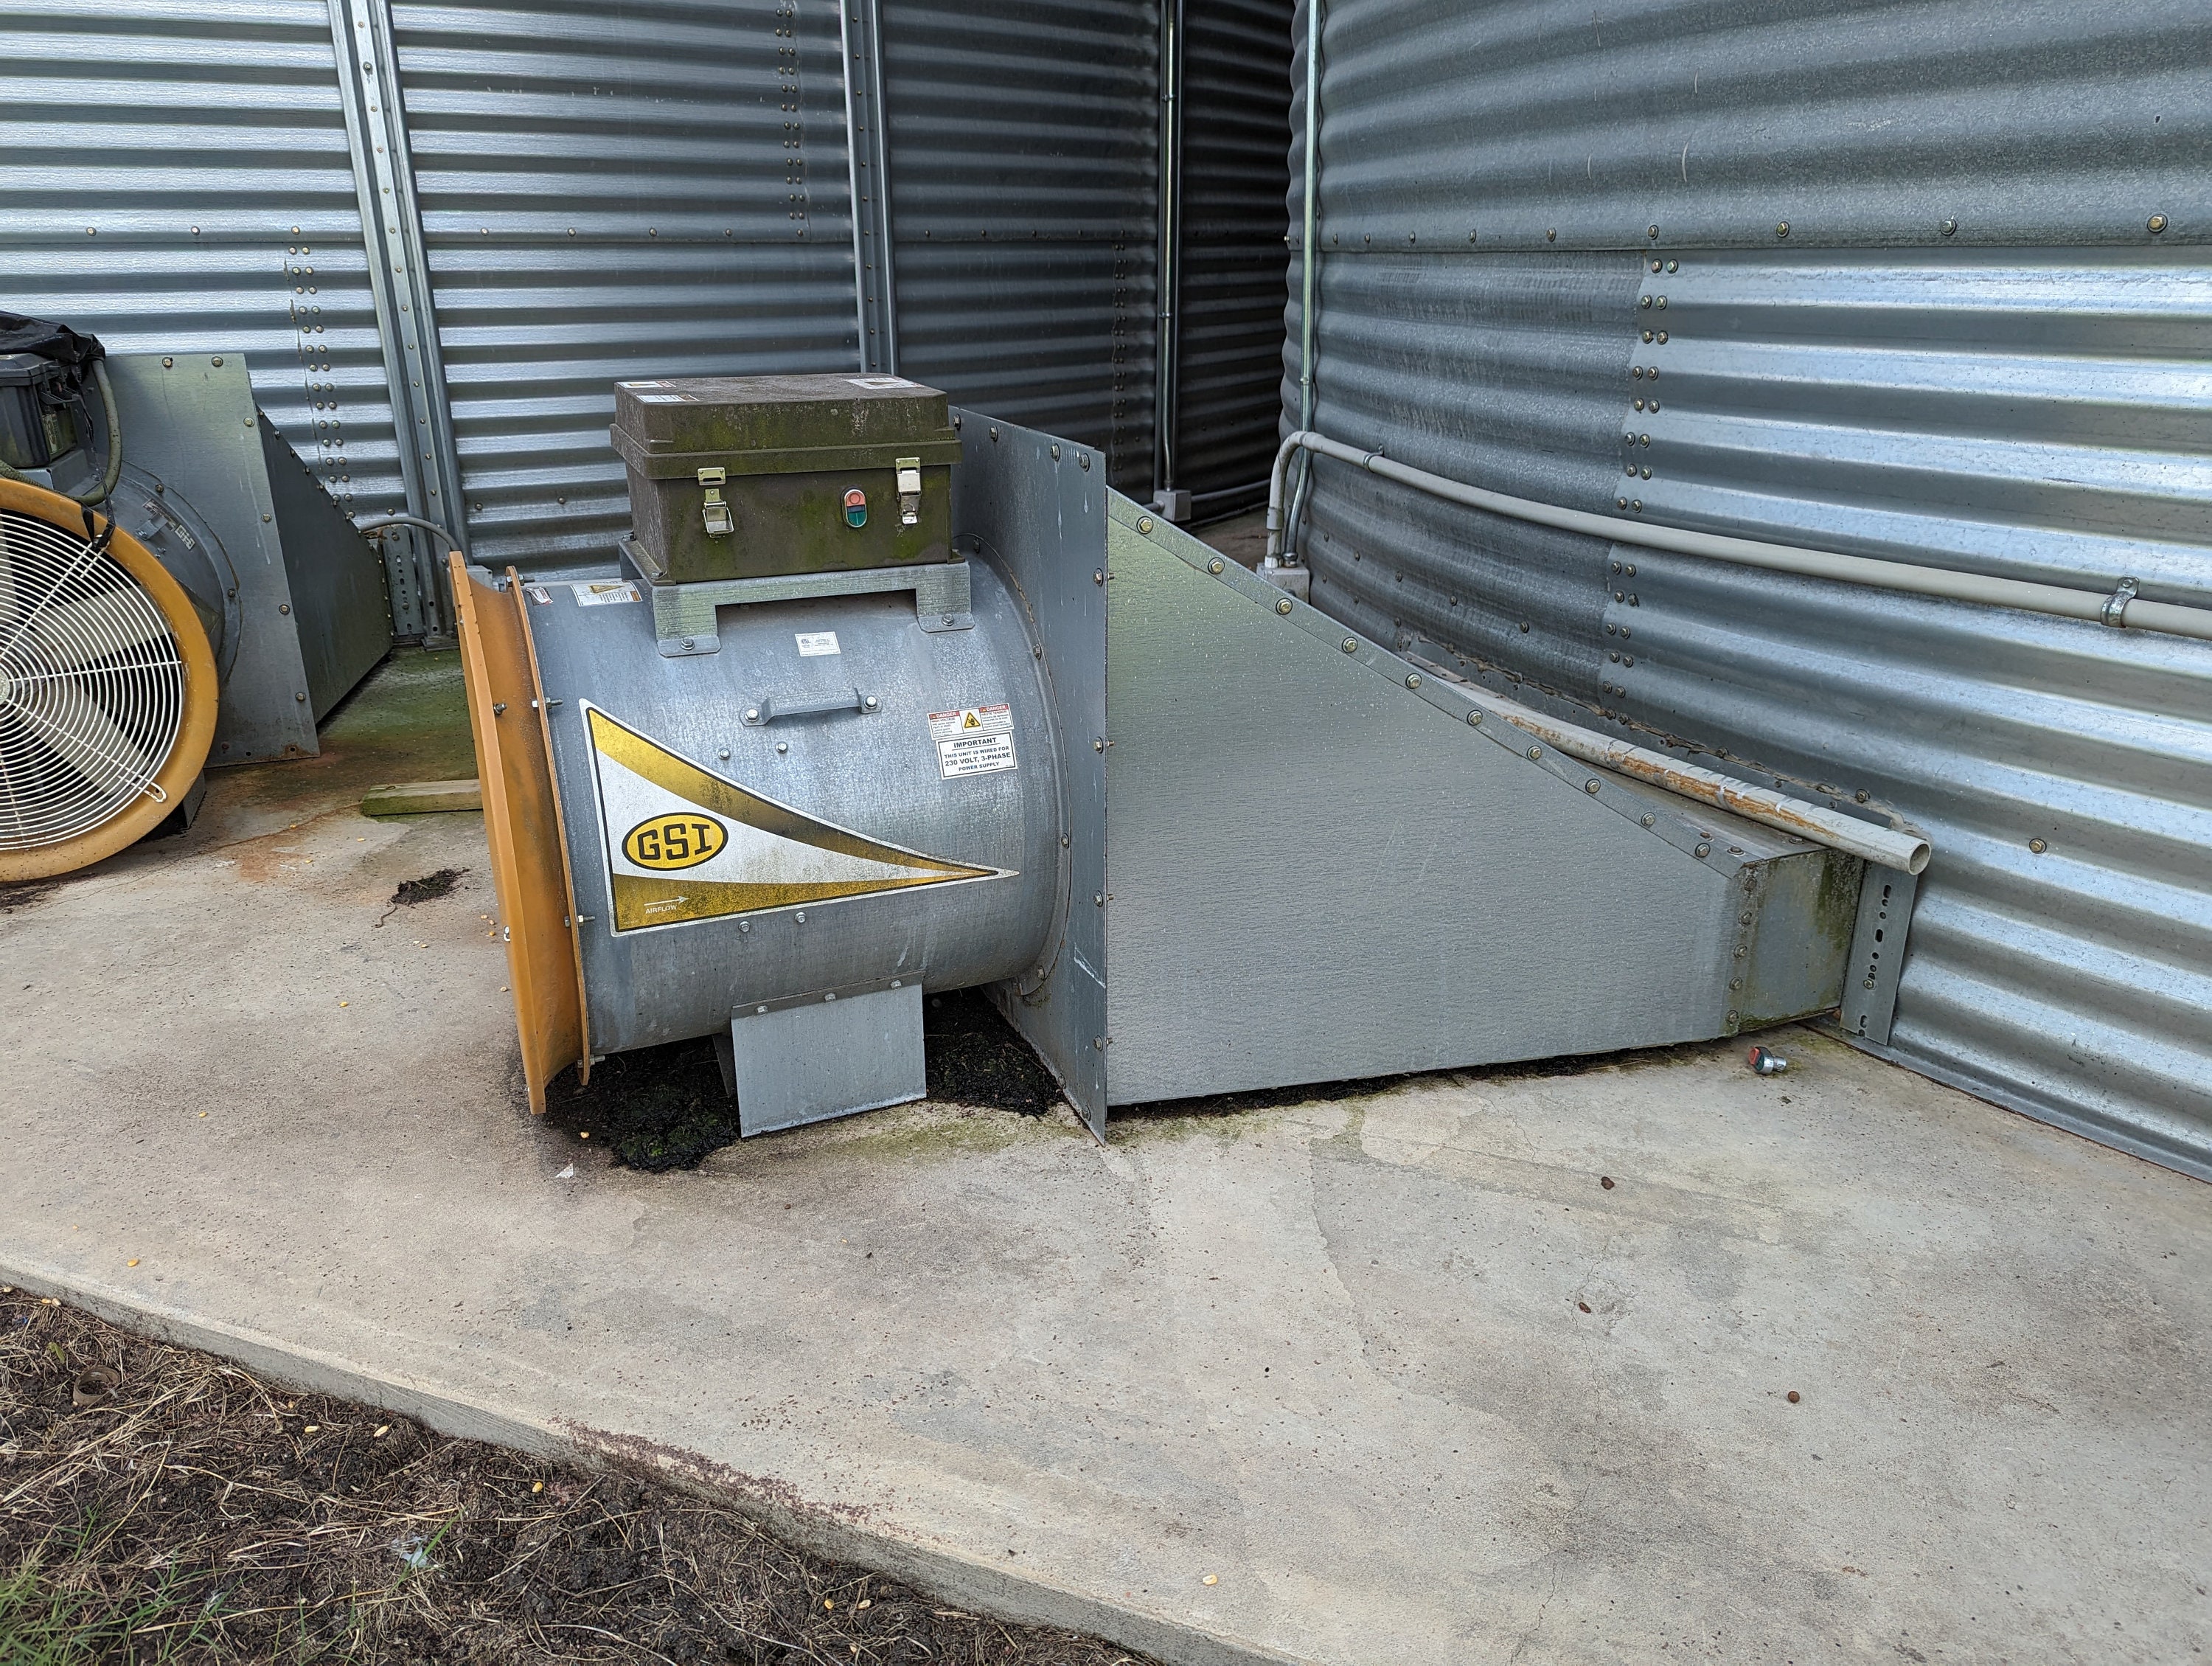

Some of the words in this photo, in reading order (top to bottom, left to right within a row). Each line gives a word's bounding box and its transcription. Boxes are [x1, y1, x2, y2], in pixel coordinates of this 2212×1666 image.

[953, 737, 997, 748] IMPORTANT
[981, 752, 1011, 761] 3-PHASE
[637, 823, 712, 861] GSI
[645, 905, 677, 914] AIRFLOW
